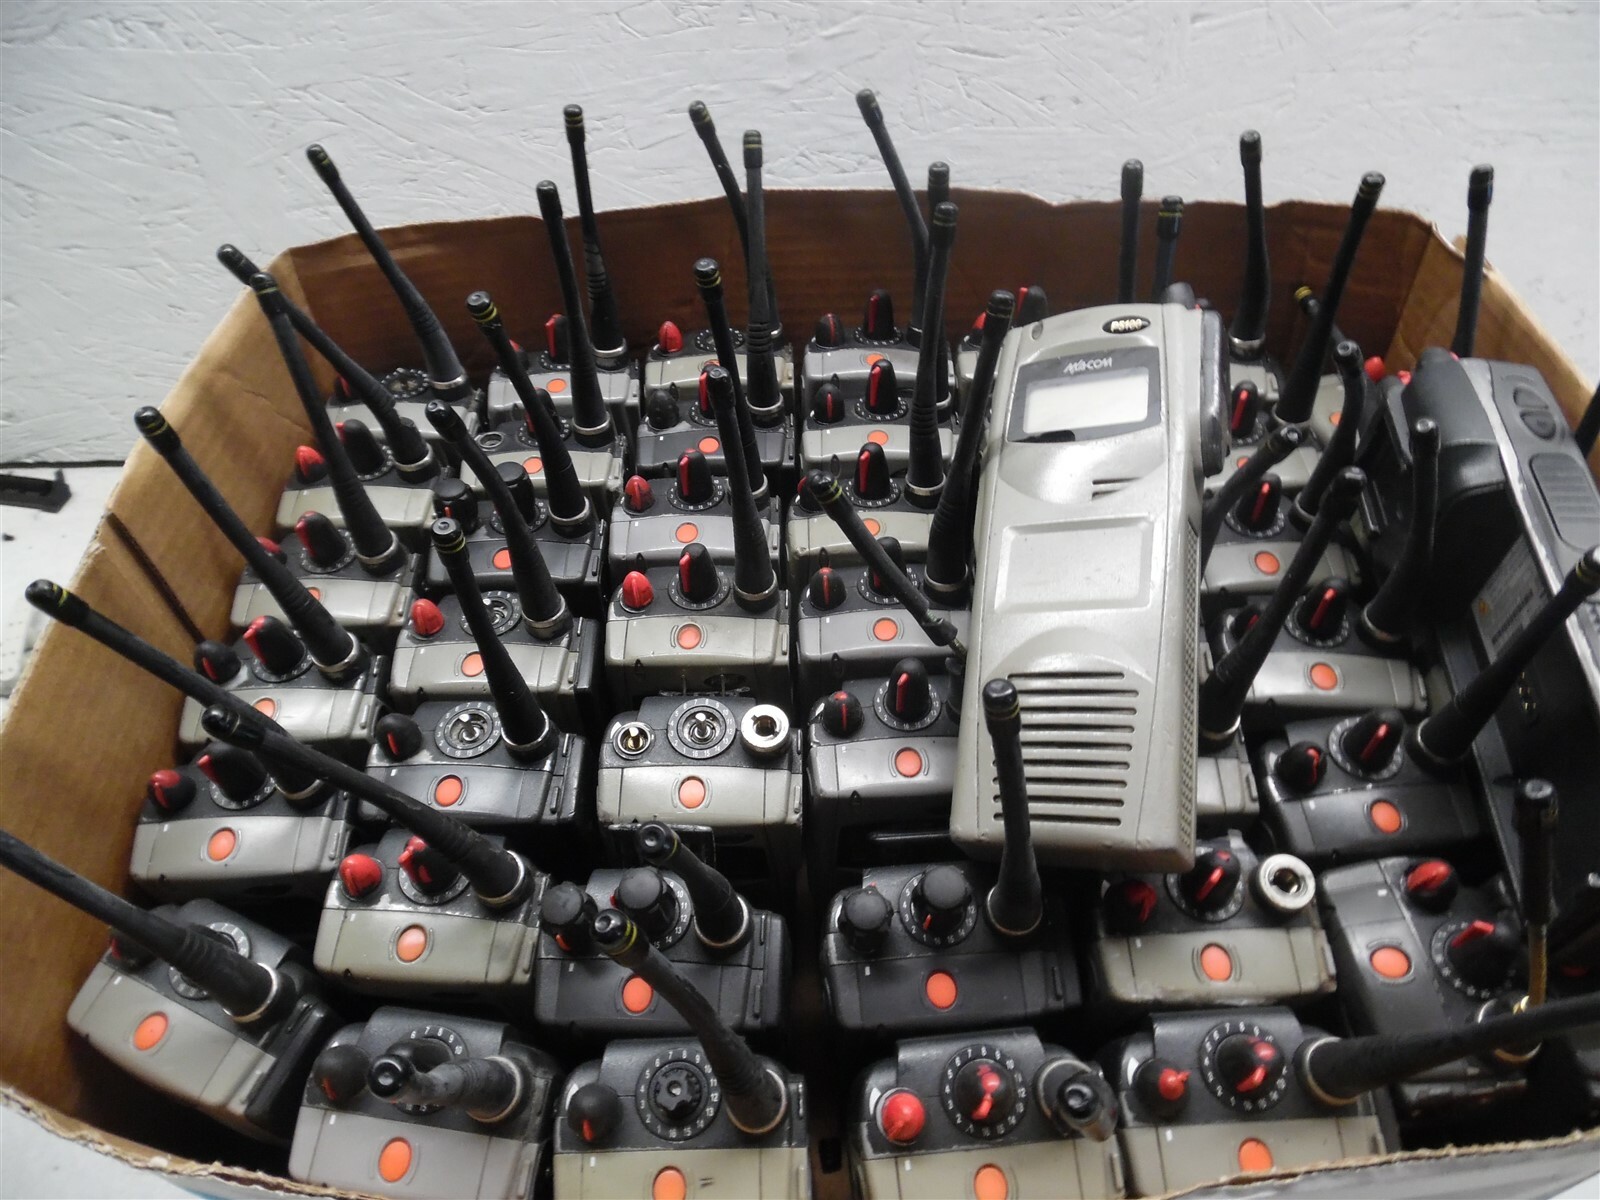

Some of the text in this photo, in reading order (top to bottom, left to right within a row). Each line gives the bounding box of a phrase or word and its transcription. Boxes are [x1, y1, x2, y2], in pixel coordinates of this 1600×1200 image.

[912, 878, 918, 887] 6
[676, 890, 684, 898] 10
[905, 888, 911, 897] 5
[902, 900, 907, 909] 4
[967, 905, 976, 914] 12
[680, 914, 688, 923] 12
[904, 913, 910, 923] 3
[675, 926, 682, 934] 13
[911, 925, 916, 935] 2
[665, 935, 673, 943] 14
[922, 933, 927, 942] 1
[1224, 1022, 1230, 1034] 7
[410, 1030, 417, 1039] 6
[424, 1026, 431, 1035] 7
[437, 1027, 444, 1037] 8
[448, 1034, 455, 1043] 9
[454, 1045, 463, 1055] 10
[967, 1048, 972, 1059] 7
[981, 1045, 987, 1057] 8
[994, 1049, 1001, 1061] 9
[955, 1056, 961, 1067] 6
[1005, 1058, 1015, 1070] 10
[947, 1068, 954, 1080] 5
[639, 1049, 719, 1138] 1 2 3 4 5 6 7 8 9 10 11 12 13 14 15 16
[944, 1084, 951, 1094] 4
[1017, 1087, 1027, 1098] 12
[947, 1099, 954, 1110] 3
[955, 1113, 962, 1124] 2
[1007, 1115, 1016, 1126] 14
[968, 1123, 974, 1134] 1
[996, 1123, 1006, 1135] 15
